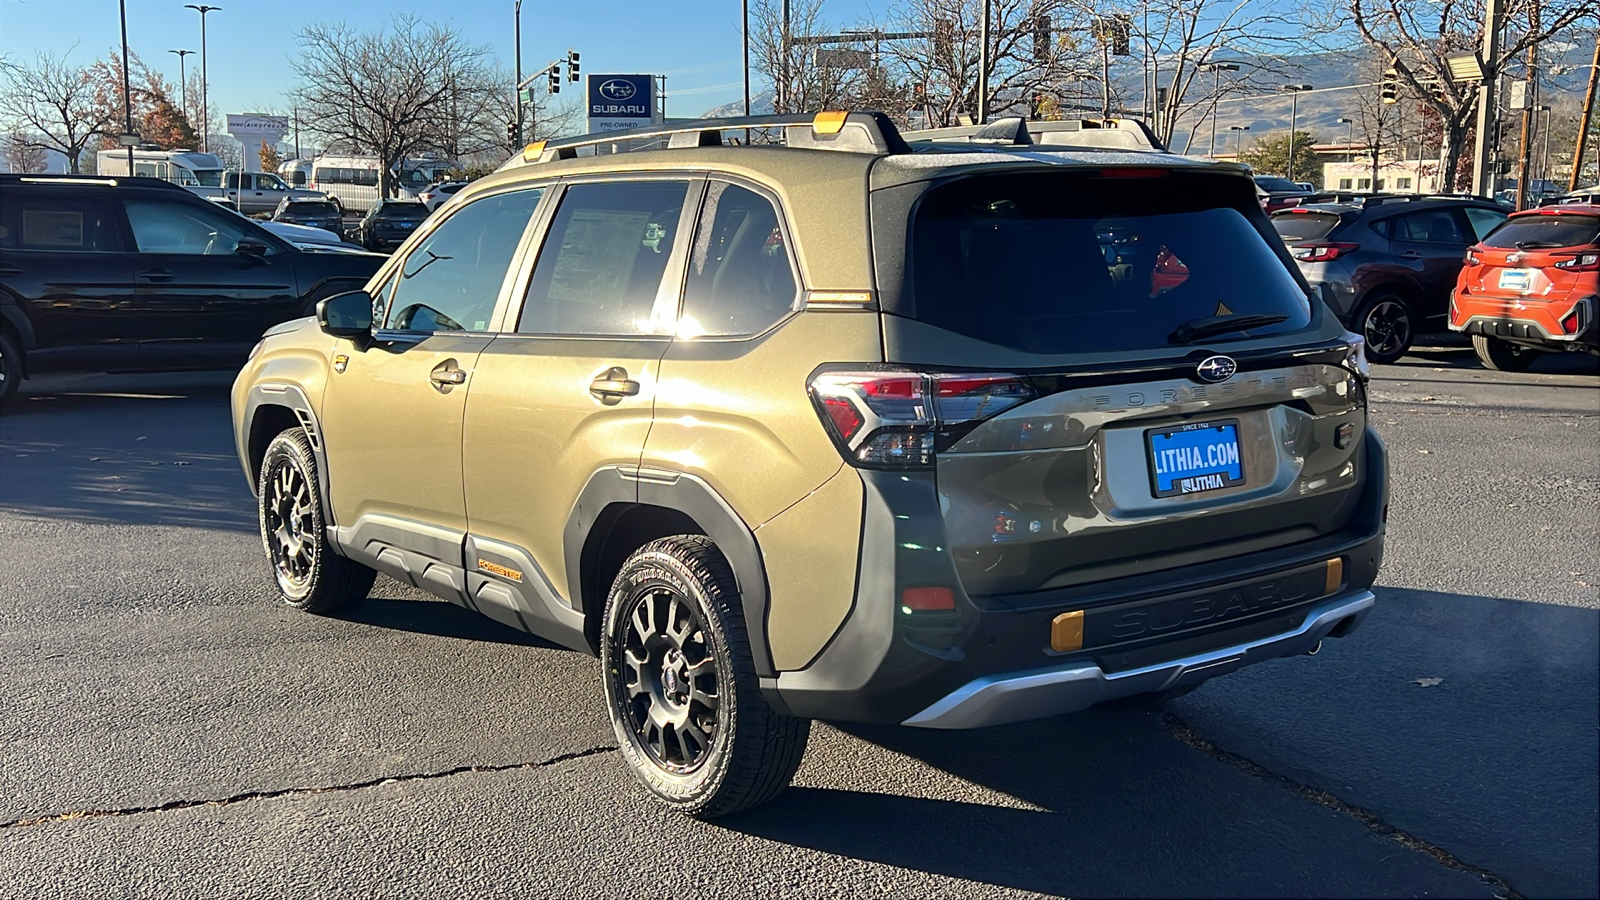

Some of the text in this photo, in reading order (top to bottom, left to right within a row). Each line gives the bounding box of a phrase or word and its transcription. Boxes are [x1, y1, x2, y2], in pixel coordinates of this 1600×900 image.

[592, 104, 646, 114] SUBARU
[1182, 423, 1198, 431] SINCE
[1154, 441, 1240, 474] LITHIA.COM
[1190, 474, 1224, 492] LITHIA
[478, 558, 522, 581] FORESTER
[630, 567, 690, 597] YOKOHAMA
